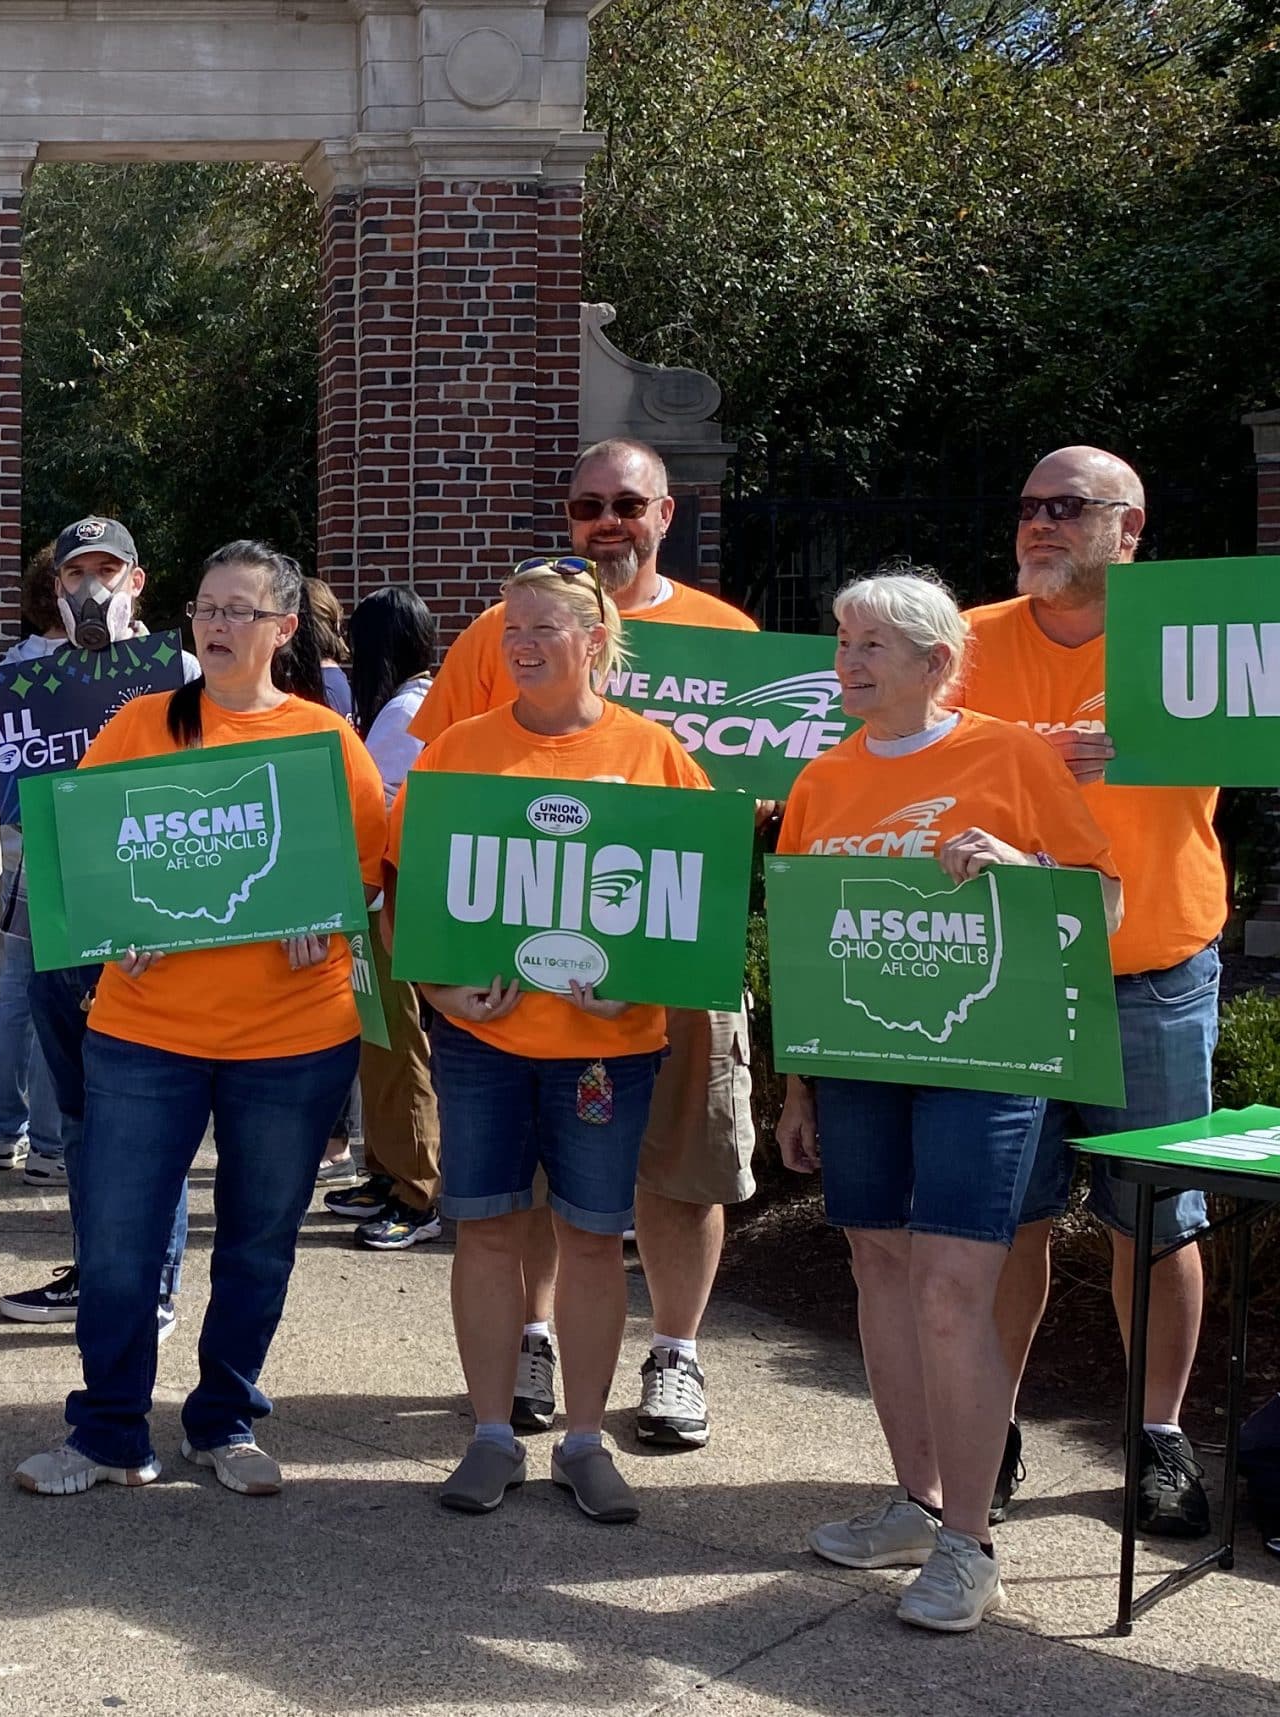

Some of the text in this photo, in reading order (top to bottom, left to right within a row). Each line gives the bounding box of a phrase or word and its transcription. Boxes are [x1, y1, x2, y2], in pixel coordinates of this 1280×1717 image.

[591, 669, 728, 705] WE ARE
[540, 802, 579, 814] UNION
[117, 802, 266, 845] AFSCME
[534, 811, 583, 824] STRONG
[116, 830, 268, 862] OHIO COUNCIL 8
[446, 833, 704, 942] UNION
[310, 920, 343, 931] AFSCME
[830, 909, 987, 945] AFSCME
[81, 947, 112, 957] AFSCME
[828, 940, 989, 965] OHIO COUNCIL 8
[523, 955, 592, 969] ALL TOGETHER
[785, 1045, 818, 1054] AFSCME
[1029, 1063, 1062, 1073] AFSCME
